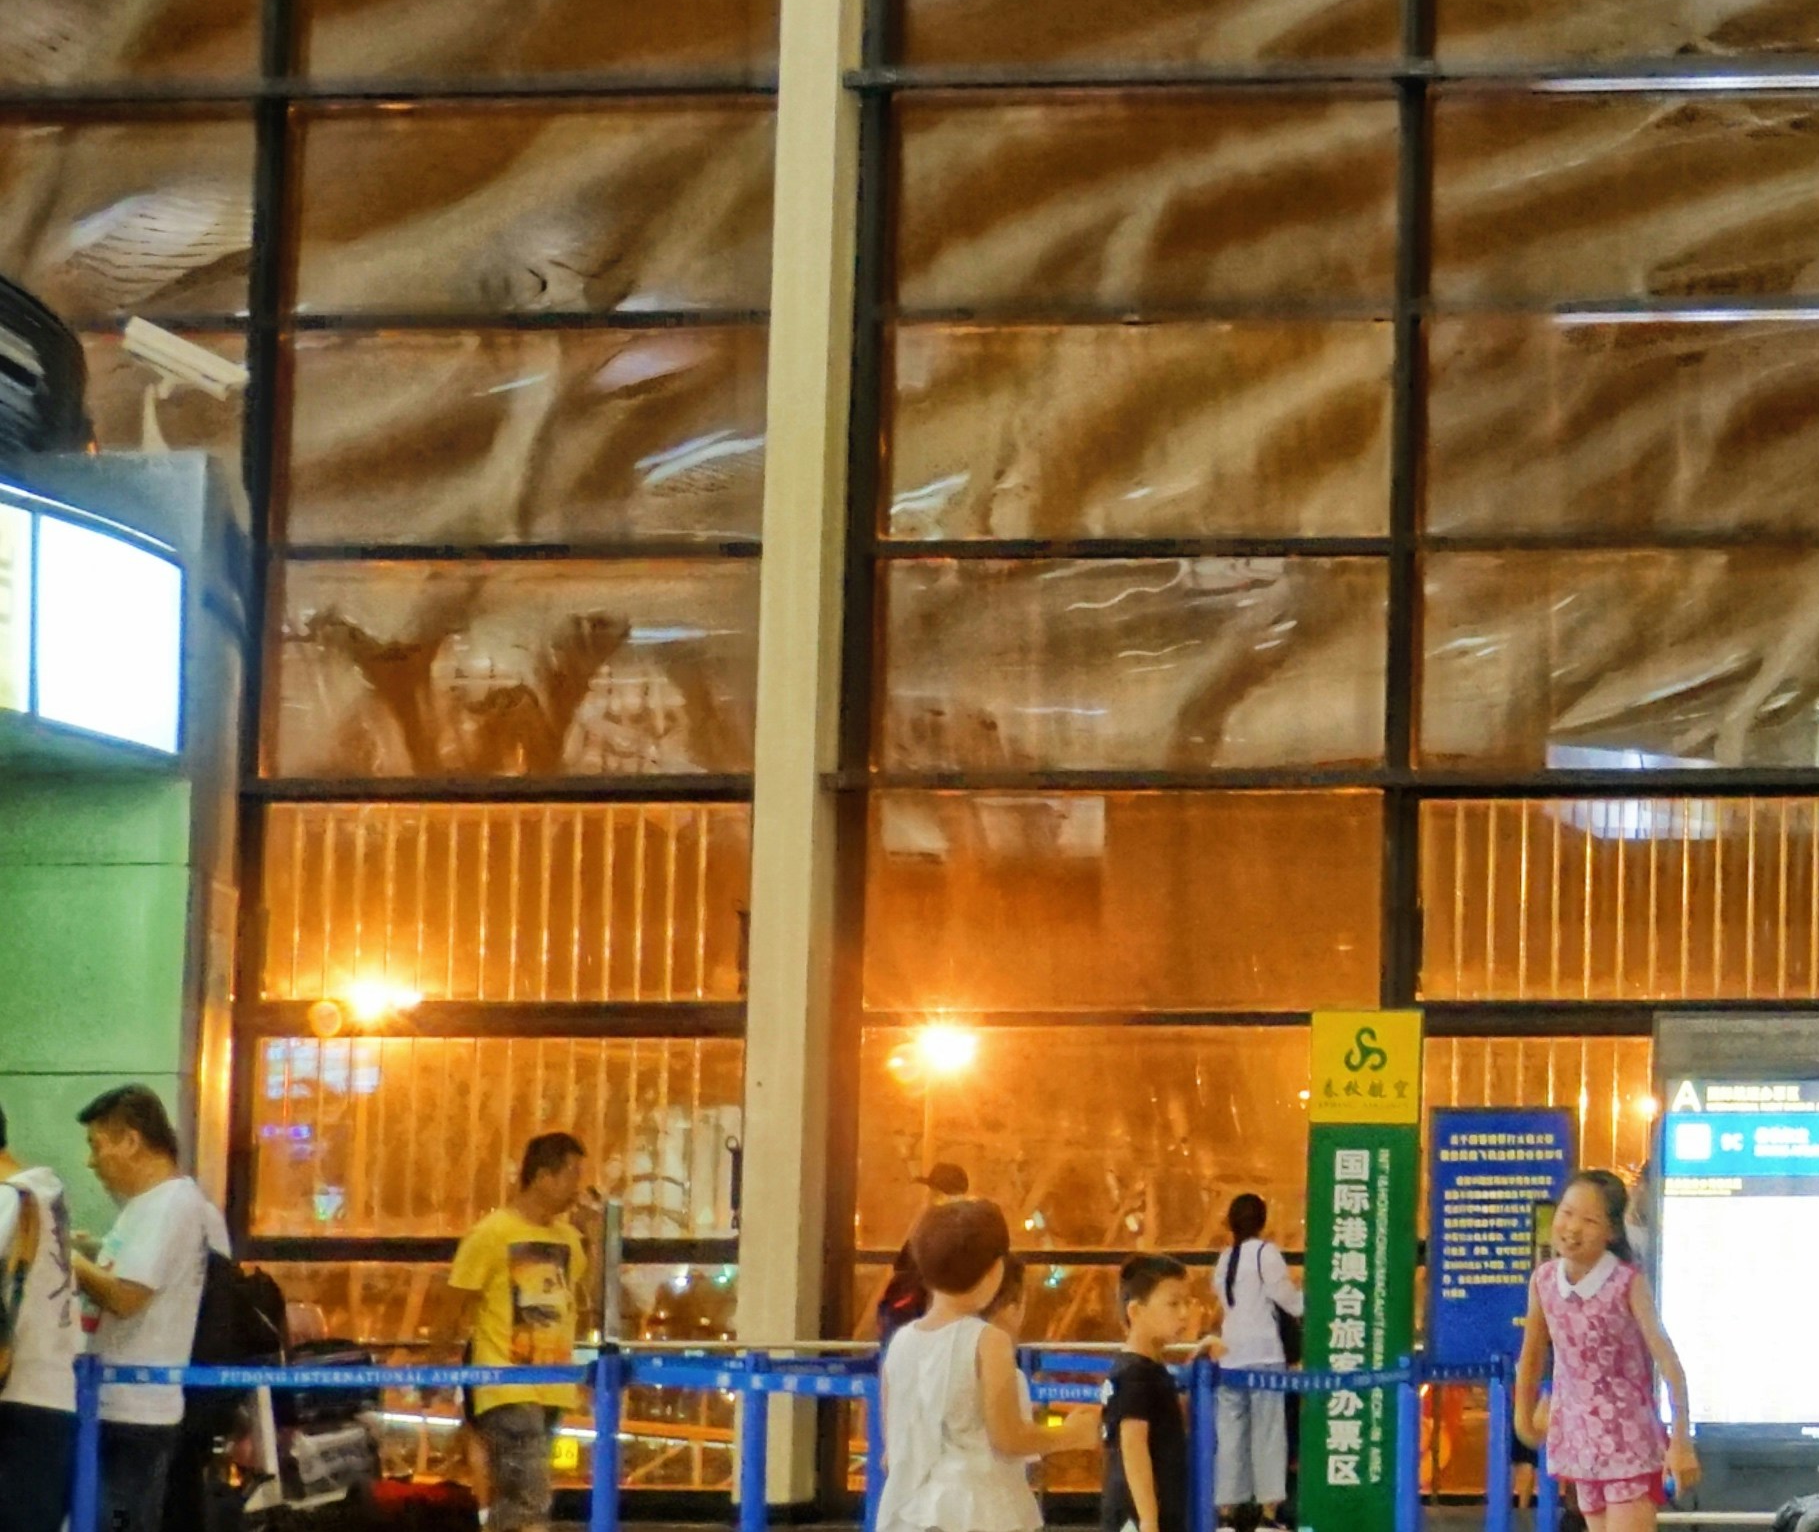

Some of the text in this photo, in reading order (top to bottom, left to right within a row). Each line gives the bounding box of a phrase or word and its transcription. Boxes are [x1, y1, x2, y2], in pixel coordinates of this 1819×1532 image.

[1671, 1079, 1702, 1112] A
[220, 1370, 504, 1384] PUDONG INTERNATIONAL AIRPORT
